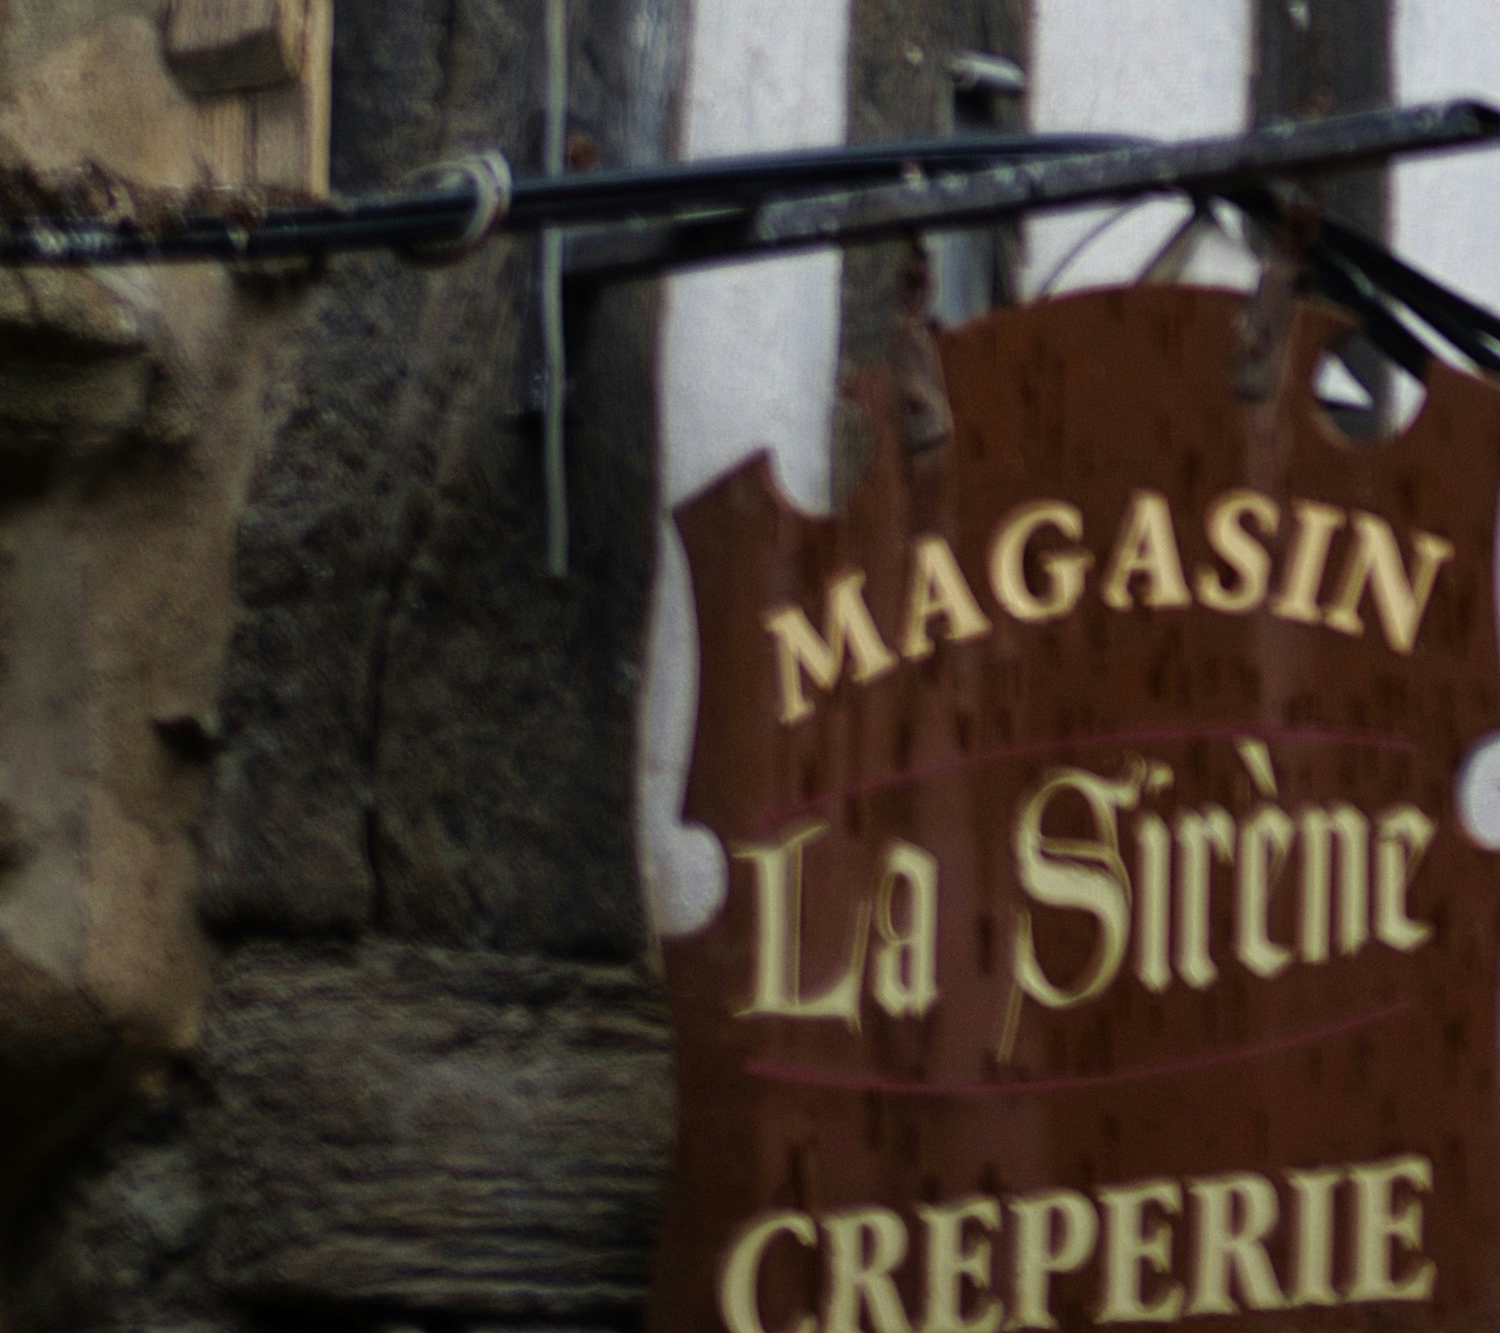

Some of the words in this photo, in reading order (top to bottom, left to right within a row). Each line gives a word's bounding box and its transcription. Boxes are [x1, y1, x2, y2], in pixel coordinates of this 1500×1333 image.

[764, 485, 1456, 727] MAGASIN
[732, 813, 940, 1037] La
[994, 735, 1438, 1063] Sirène
[717, 1151, 1439, 1333] CREPERIE
